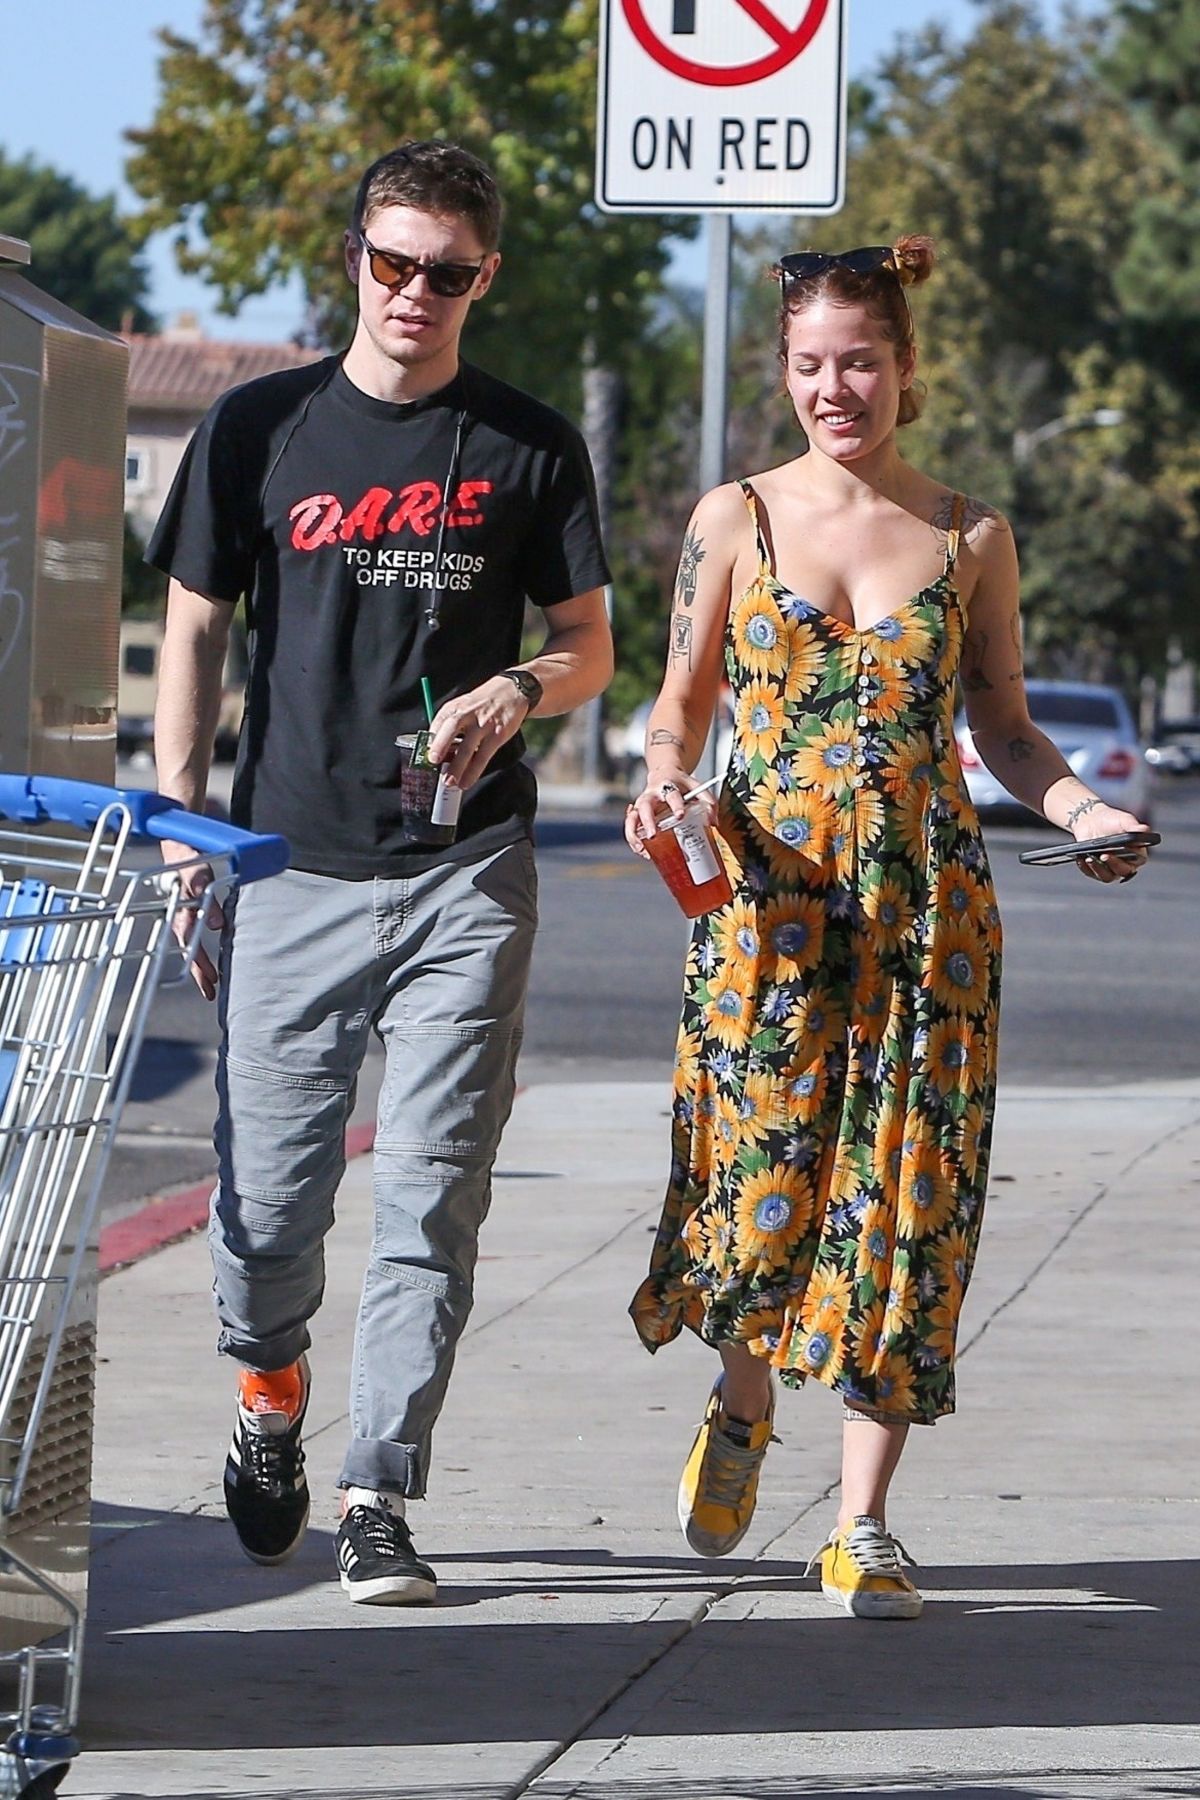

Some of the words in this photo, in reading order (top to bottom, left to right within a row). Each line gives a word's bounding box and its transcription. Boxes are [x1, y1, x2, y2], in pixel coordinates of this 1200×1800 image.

[632, 117, 692, 170] ON
[719, 117, 811, 170] RED
[342, 547, 371, 566] TO
[377, 549, 435, 568] KEEP
[440, 552, 485, 573] KIDS
[356, 568, 400, 587] OFF
[404, 570, 473, 591] DRUGS.
